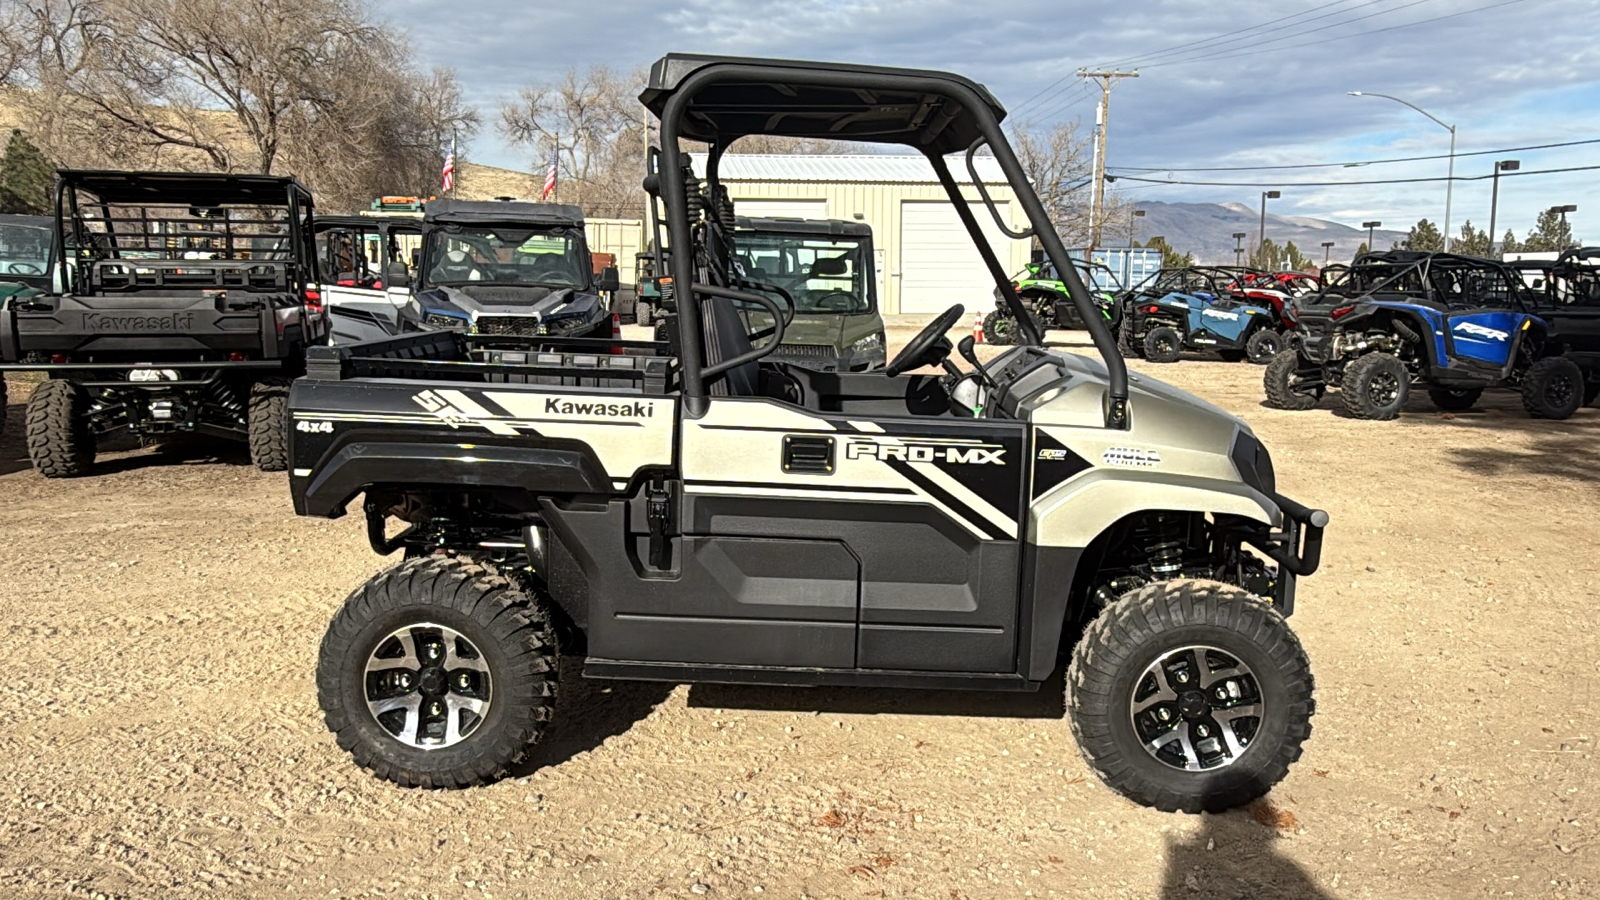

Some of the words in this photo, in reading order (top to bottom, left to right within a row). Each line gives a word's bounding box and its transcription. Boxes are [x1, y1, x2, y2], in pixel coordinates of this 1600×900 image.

[82, 312, 194, 330] Kawasaki
[1453, 321, 1509, 342] RZR
[544, 398, 654, 418] Kawasaki
[296, 420, 334, 433] 4x4
[846, 442, 1007, 466] PRO-MX
